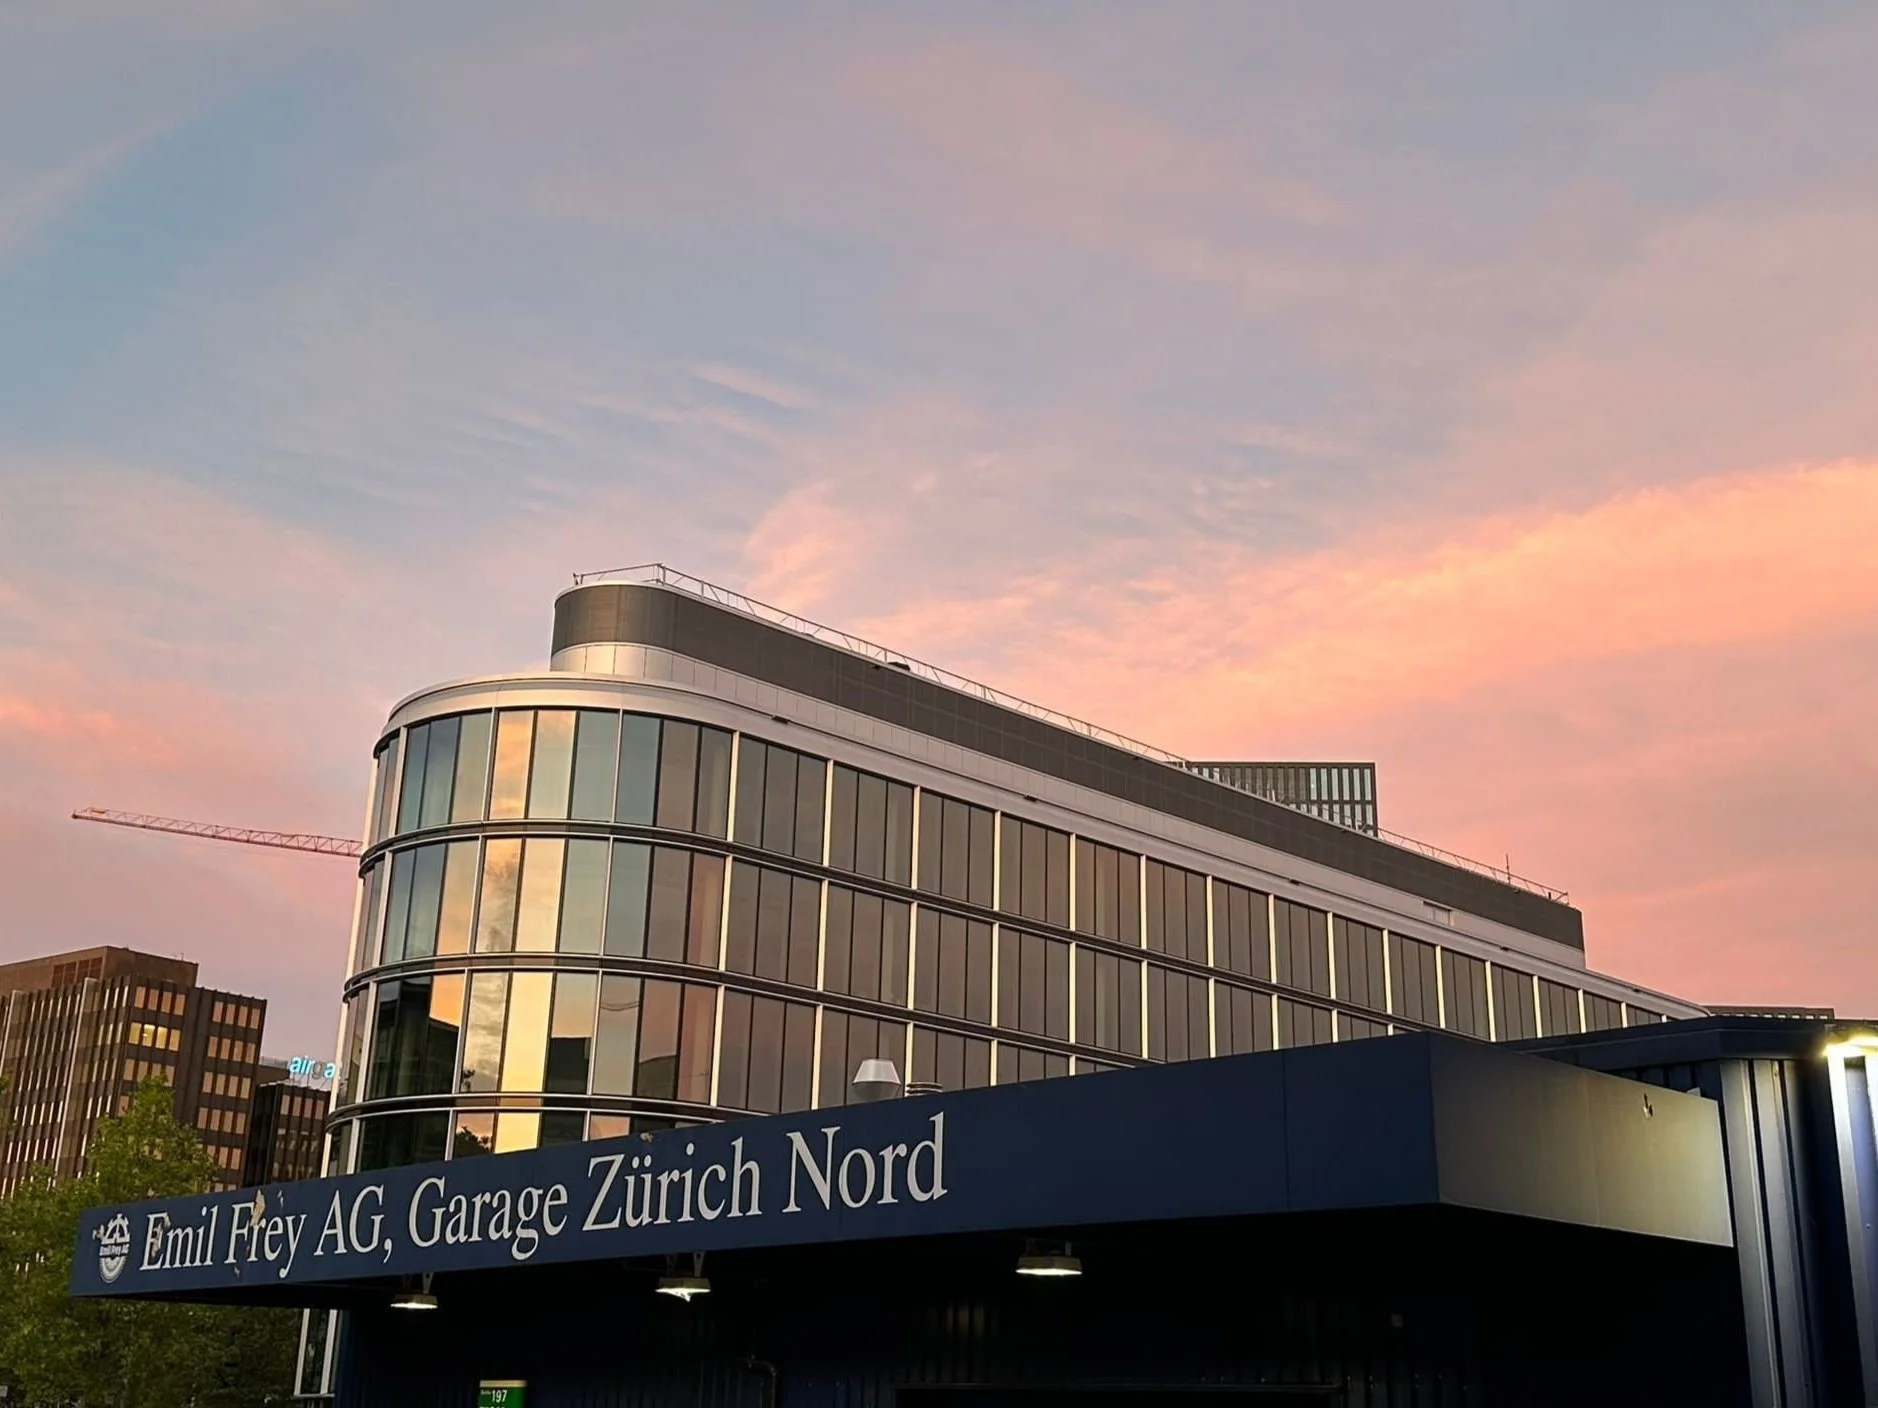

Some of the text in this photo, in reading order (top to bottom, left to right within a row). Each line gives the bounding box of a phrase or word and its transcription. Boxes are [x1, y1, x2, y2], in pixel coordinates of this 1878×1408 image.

[139, 1111, 947, 1279] Emil Frey AG, Garage Zürich Nord
[492, 1389, 508, 1403] 197
